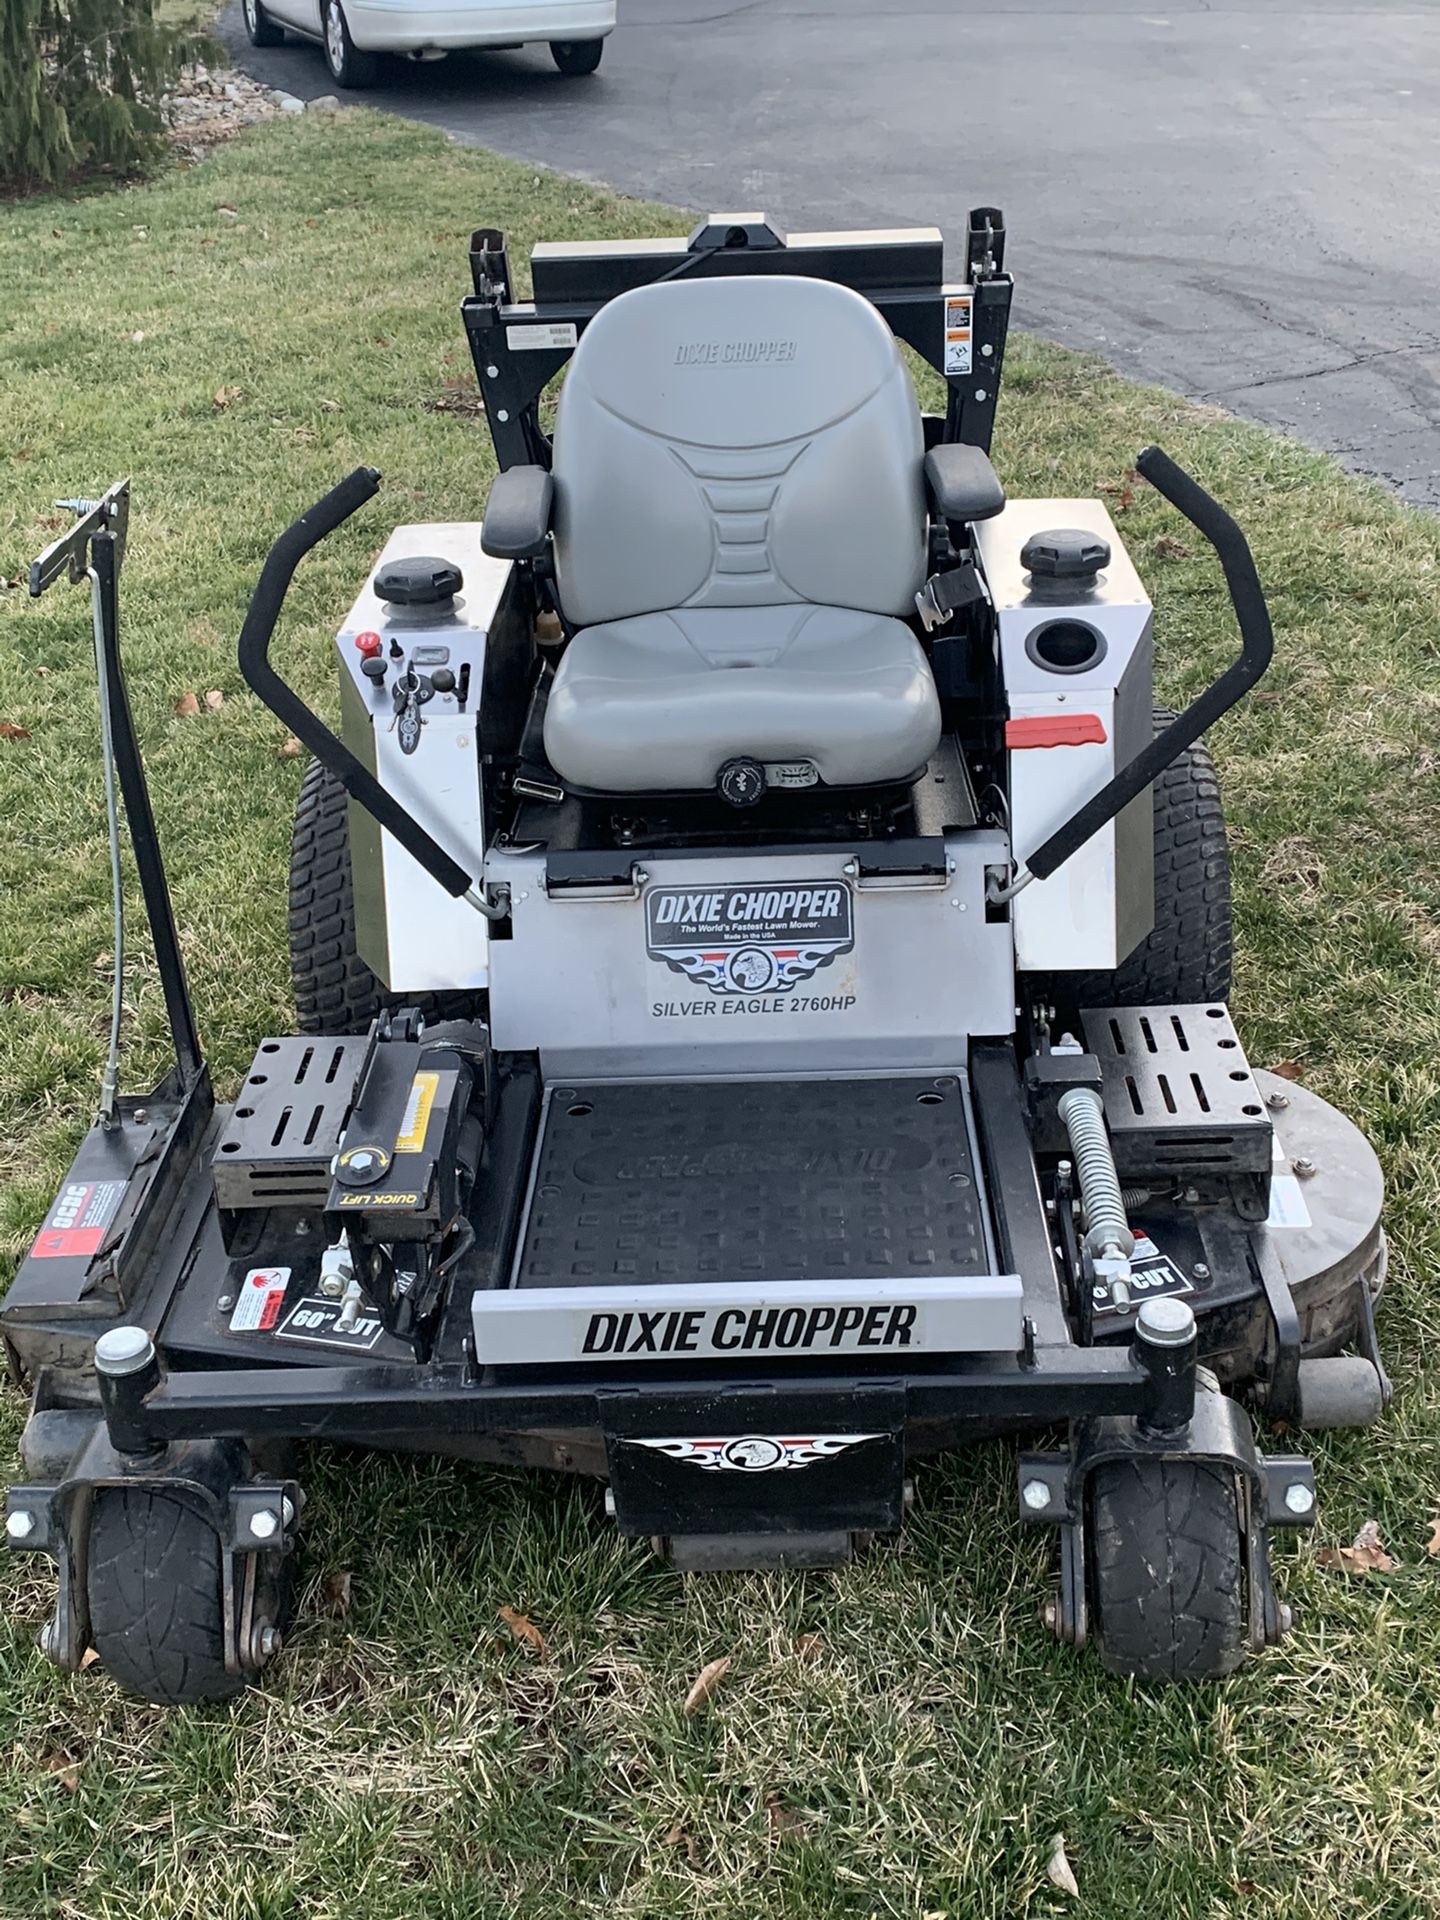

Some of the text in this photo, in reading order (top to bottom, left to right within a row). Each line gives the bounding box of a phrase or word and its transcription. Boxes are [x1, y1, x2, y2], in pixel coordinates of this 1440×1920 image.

[673, 338, 797, 366] DIXIE CHOPPER
[655, 894, 724, 924] DIXIE
[681, 924, 697, 933] The
[698, 922, 730, 932] World's
[732, 919, 763, 931] Fastest
[765, 918, 788, 930] Lawn
[750, 931, 761, 939] the
[761, 930, 776, 939] USA
[652, 996, 857, 1018] SILVER EAGLE 2760HP
[339, 1193, 417, 1205] QUICK LIFT
[1131, 1266, 1175, 1290] CUT
[582, 1311, 706, 1353] DIXIE
